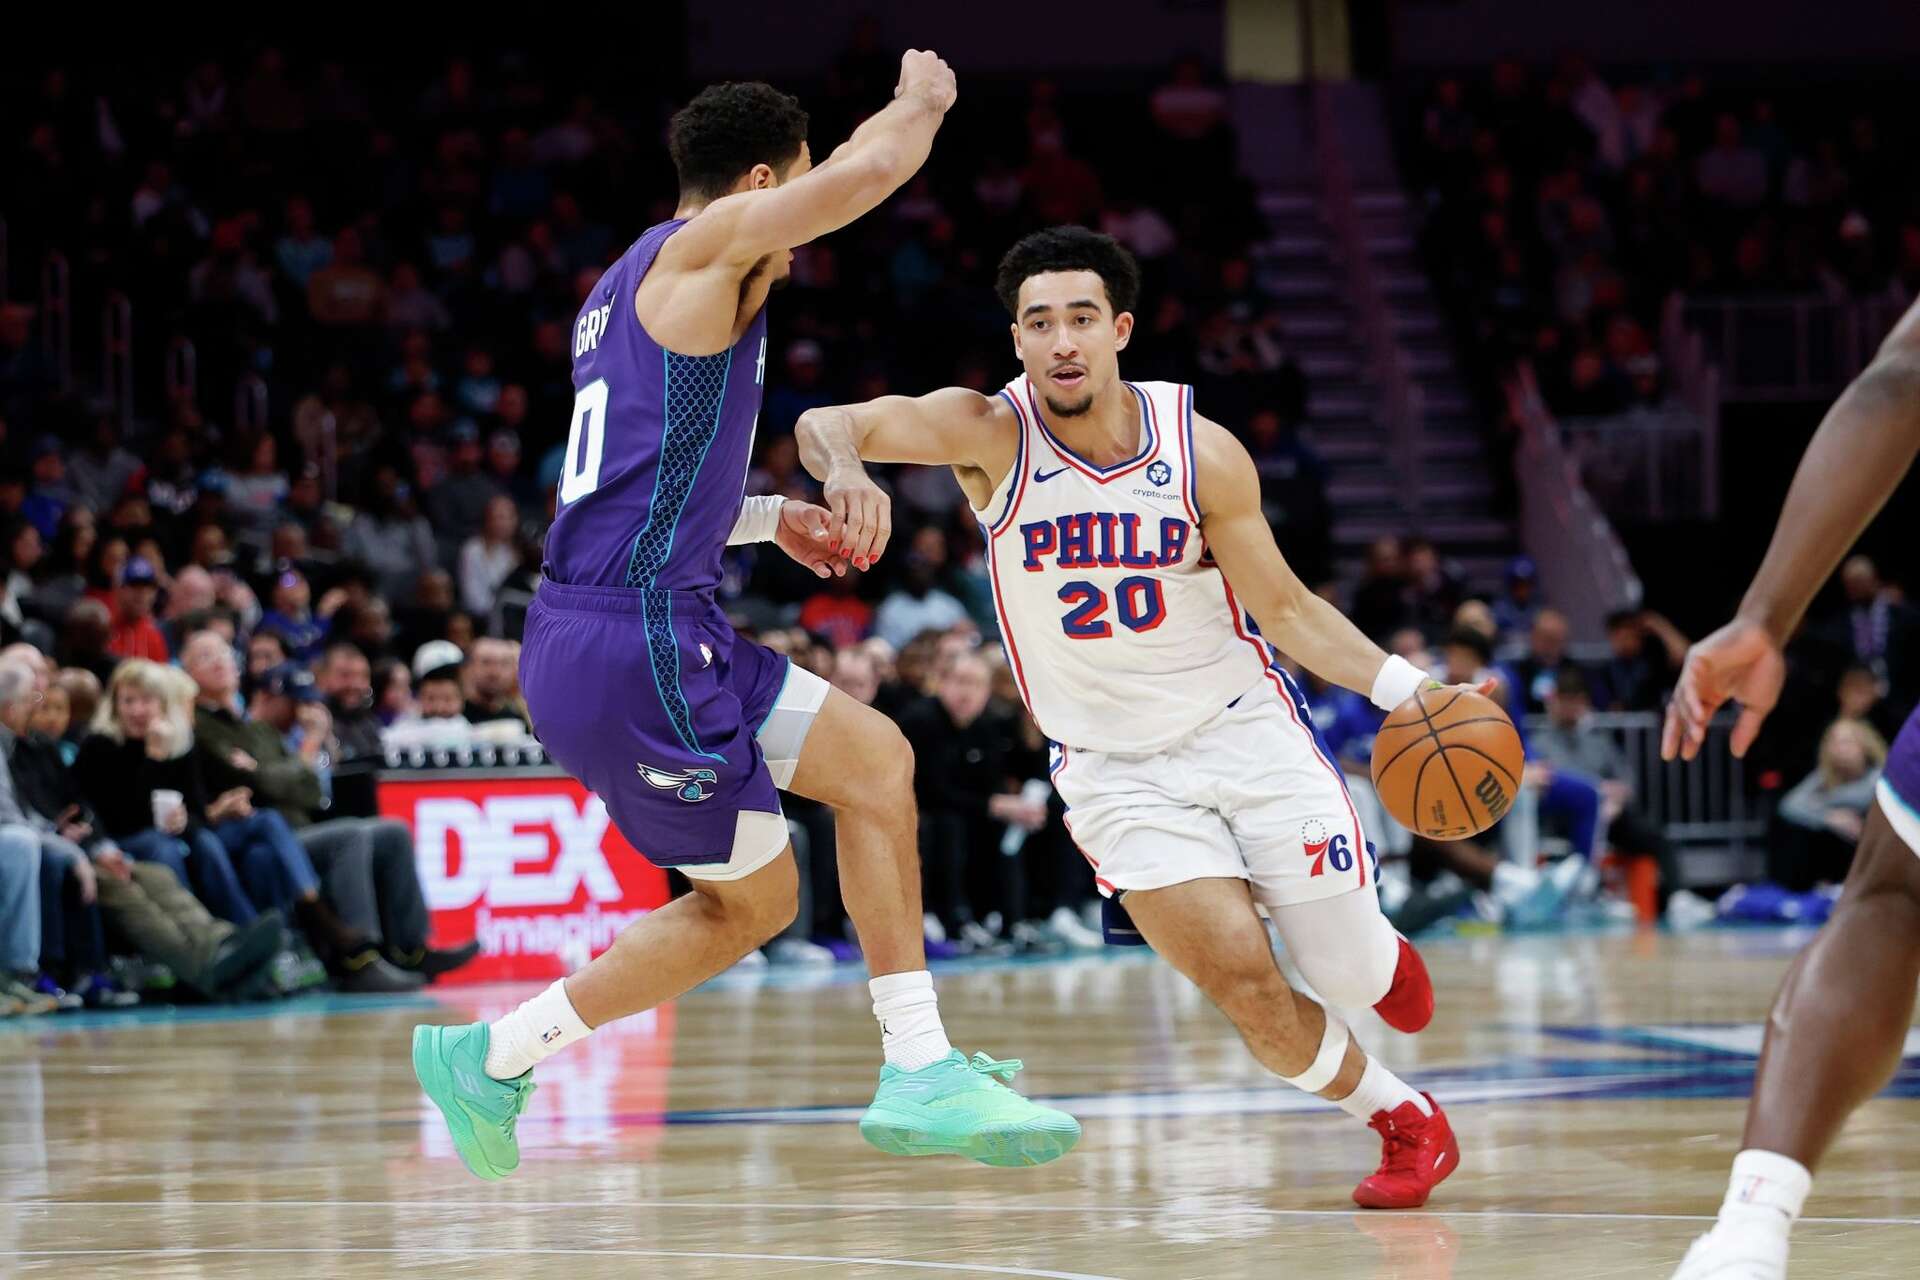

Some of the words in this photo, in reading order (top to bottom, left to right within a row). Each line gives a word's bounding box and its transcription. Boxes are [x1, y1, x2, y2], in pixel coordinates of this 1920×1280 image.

[556, 376, 609, 505] 0
[1132, 488, 1182, 501] crypto.com
[1019, 511, 1191, 572] PHILA
[1057, 575, 1167, 640] 20
[414, 791, 624, 911] DEX
[1302, 833, 1353, 878] 76
[476, 902, 651, 970] imagin
